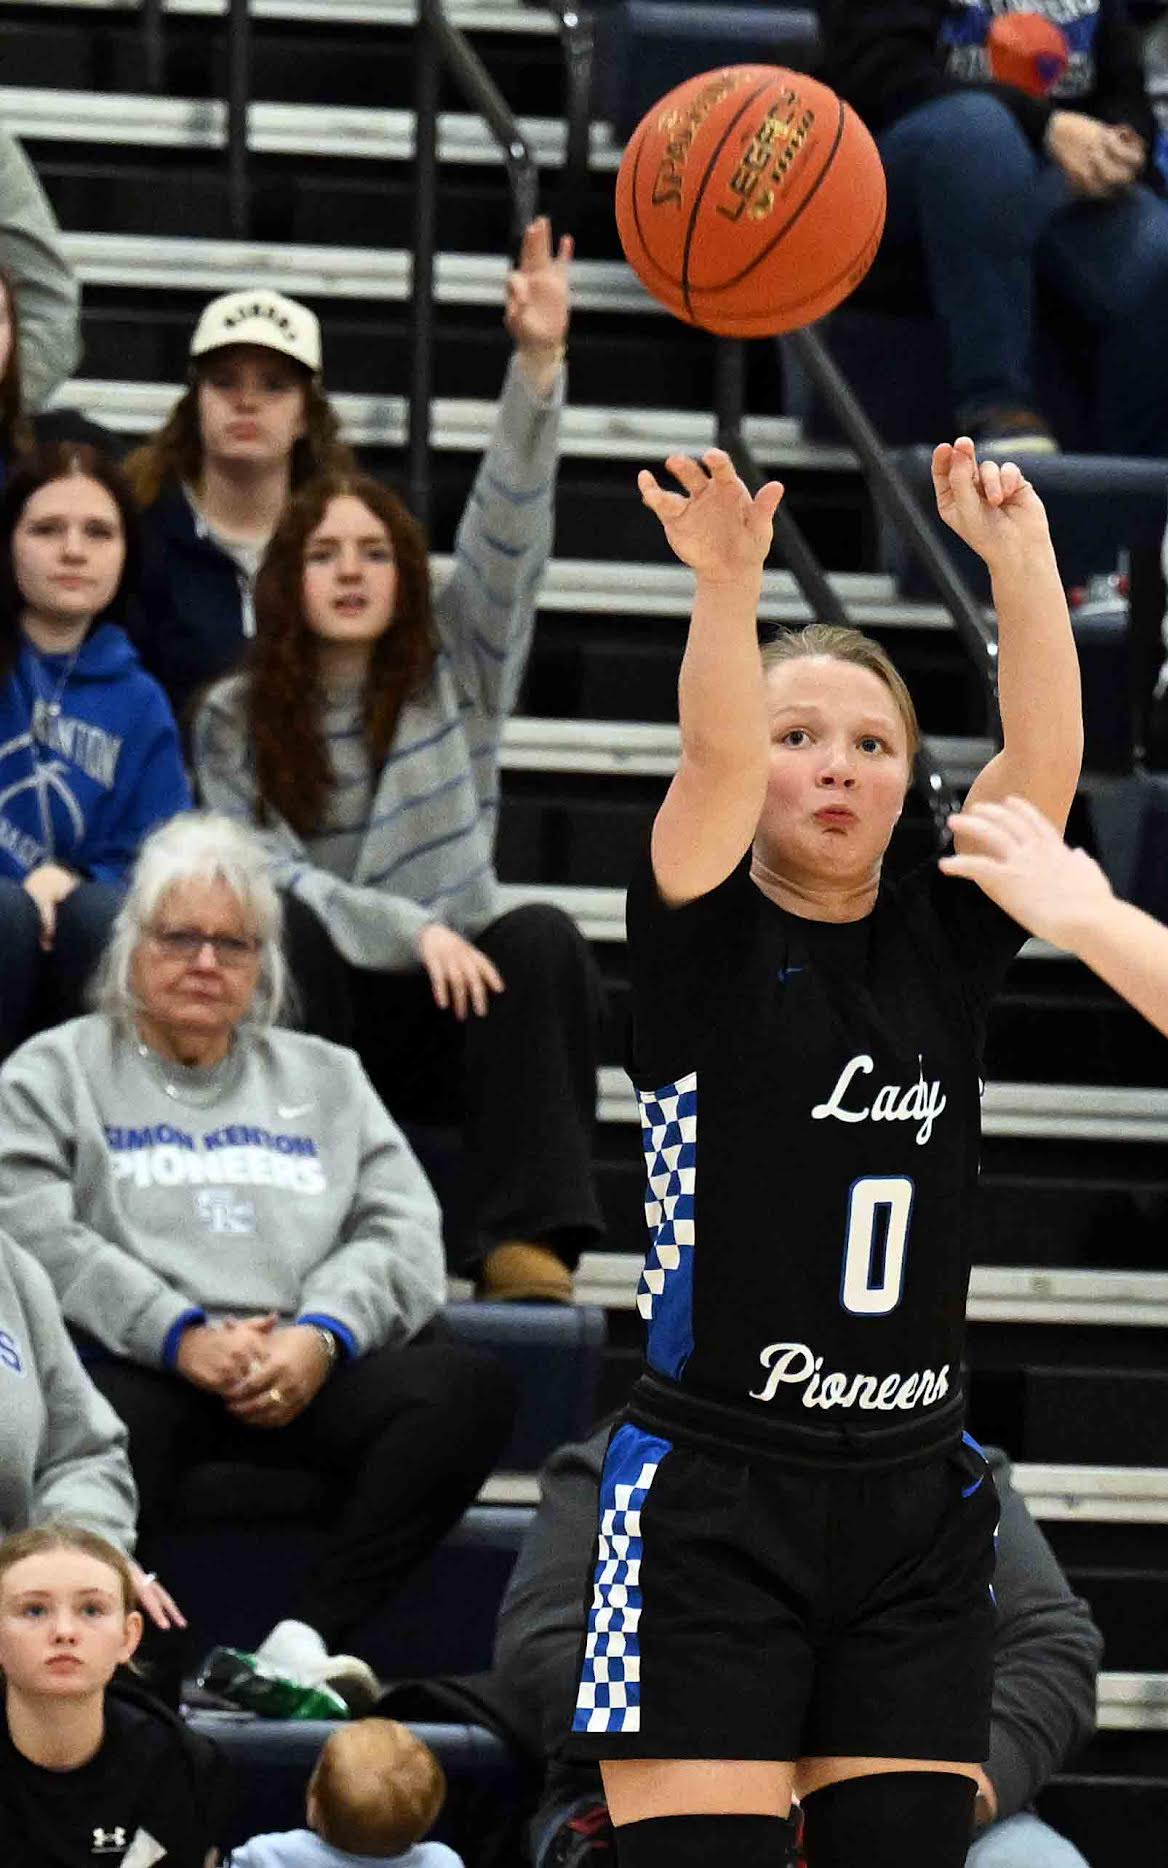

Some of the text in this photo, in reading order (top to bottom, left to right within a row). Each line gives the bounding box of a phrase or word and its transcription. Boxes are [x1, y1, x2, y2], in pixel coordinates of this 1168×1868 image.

[811, 1054, 946, 1146] Lady
[104, 1122, 318, 1158] SIMON KENTON
[107, 1149, 326, 1196] PIONEERS
[839, 1175, 914, 1316] 0
[749, 1342, 950, 1410] Pioneers
